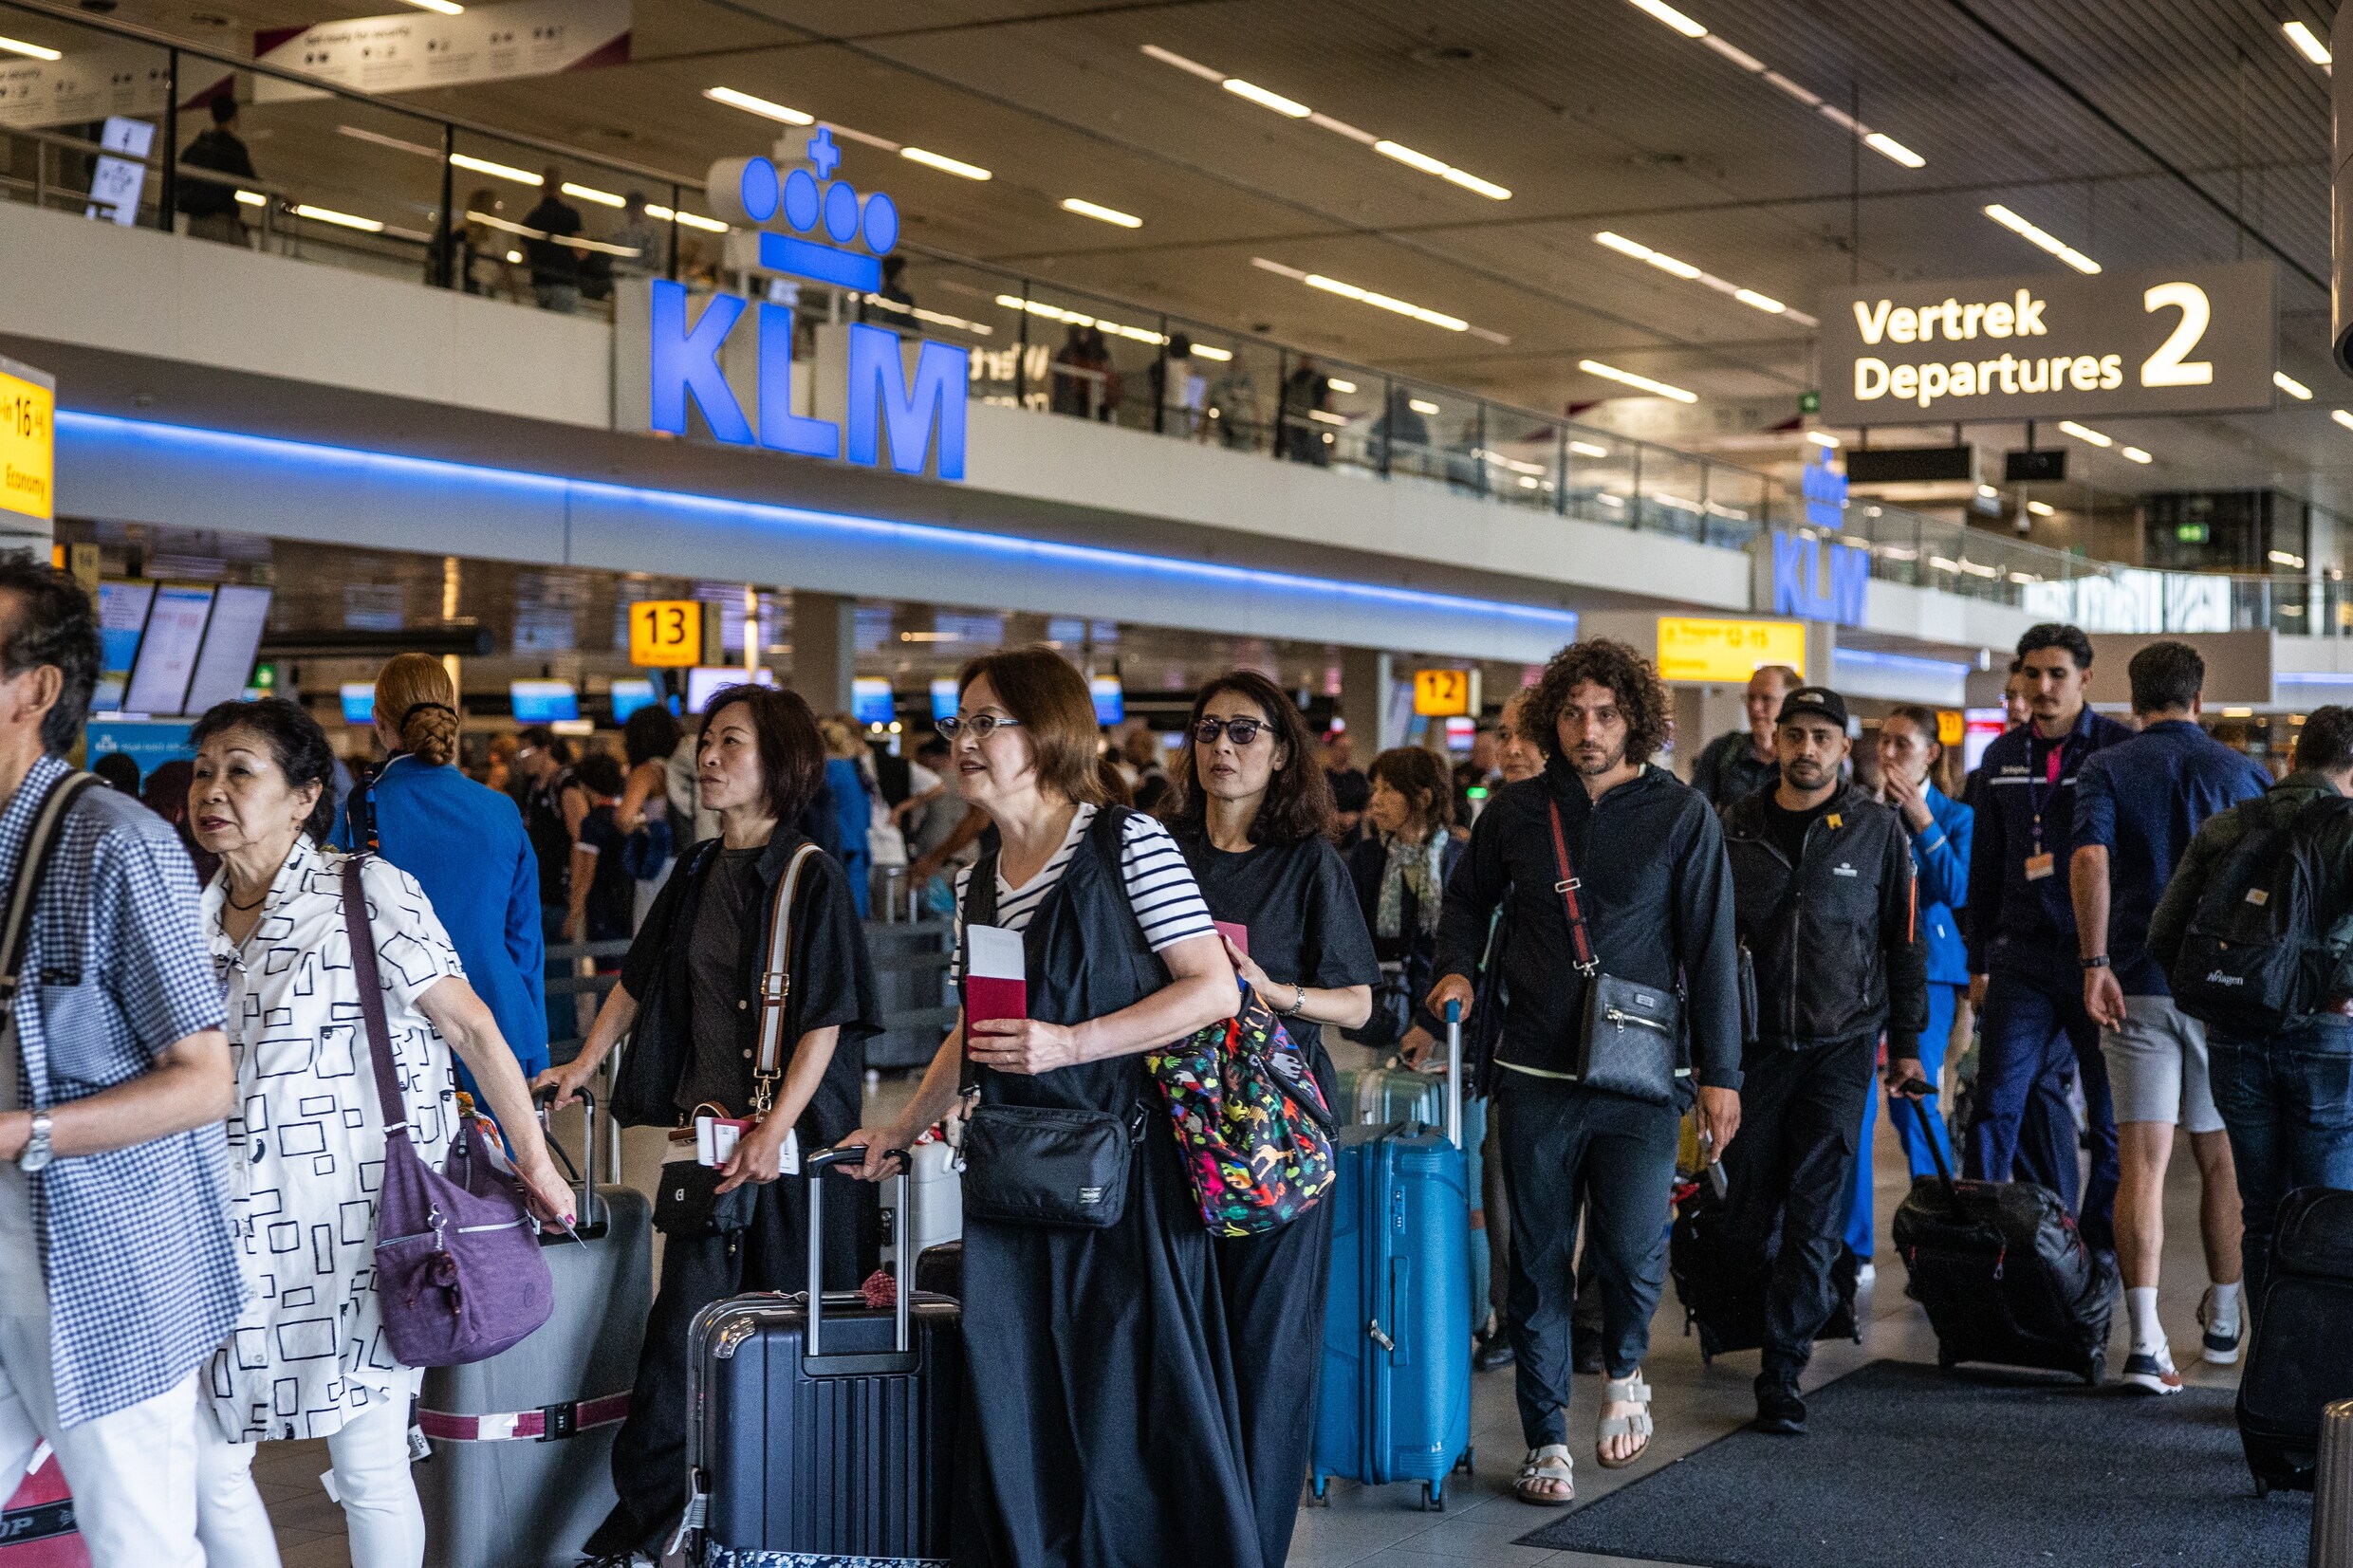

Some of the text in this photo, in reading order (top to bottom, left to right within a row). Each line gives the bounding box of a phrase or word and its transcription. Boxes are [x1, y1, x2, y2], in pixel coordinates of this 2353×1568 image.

[1853, 287, 2048, 344] Vertrek
[2140, 282, 2214, 387] 2
[651, 278, 969, 481] KLM
[1854, 352, 2124, 408] Departures
[15, 397, 31, 437] 16
[7, 463, 46, 503] Economy
[1773, 530, 1870, 628] KLM
[644, 608, 685, 644] 13
[1428, 673, 1458, 700] 12
